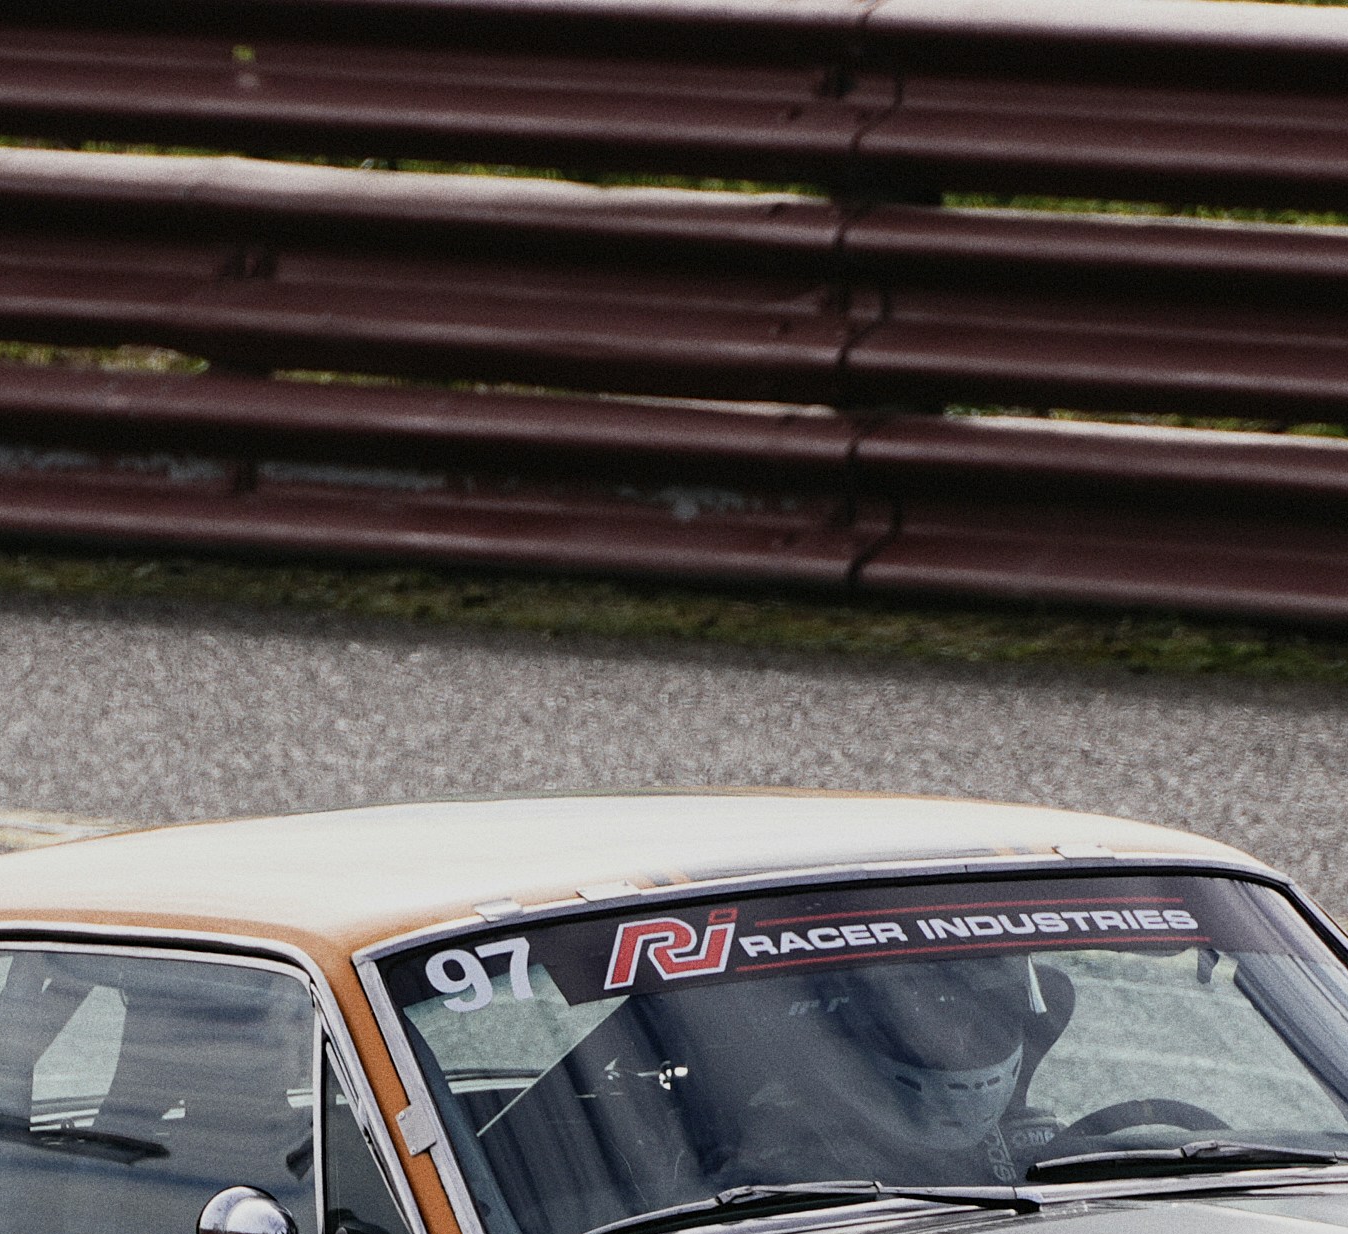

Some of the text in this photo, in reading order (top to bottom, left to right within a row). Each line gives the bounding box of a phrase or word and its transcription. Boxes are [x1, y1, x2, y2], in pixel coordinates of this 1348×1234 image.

[738, 909, 1199, 958] RACER INDUSTRIES
[425, 936, 534, 1013] 97
